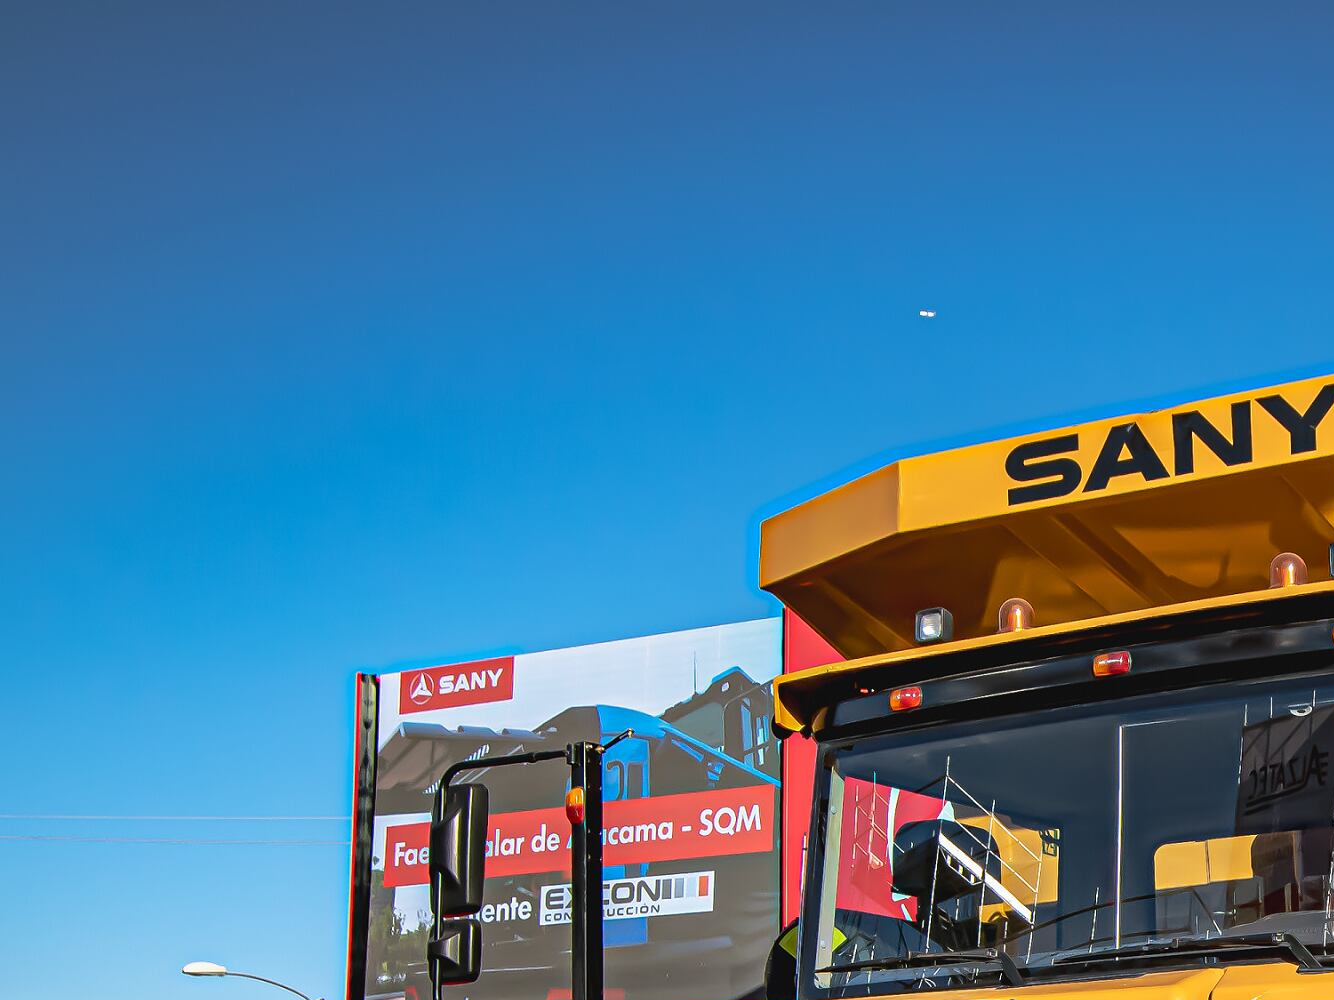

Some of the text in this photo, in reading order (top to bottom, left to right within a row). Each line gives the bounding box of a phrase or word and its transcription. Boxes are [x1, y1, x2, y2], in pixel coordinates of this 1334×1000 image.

[439, 668, 504, 695] SANY
[484, 828, 525, 858] alar
[531, 823, 561, 853] de
[698, 804, 763, 838] SQM
[544, 903, 661, 922] CONUCCIÓN
